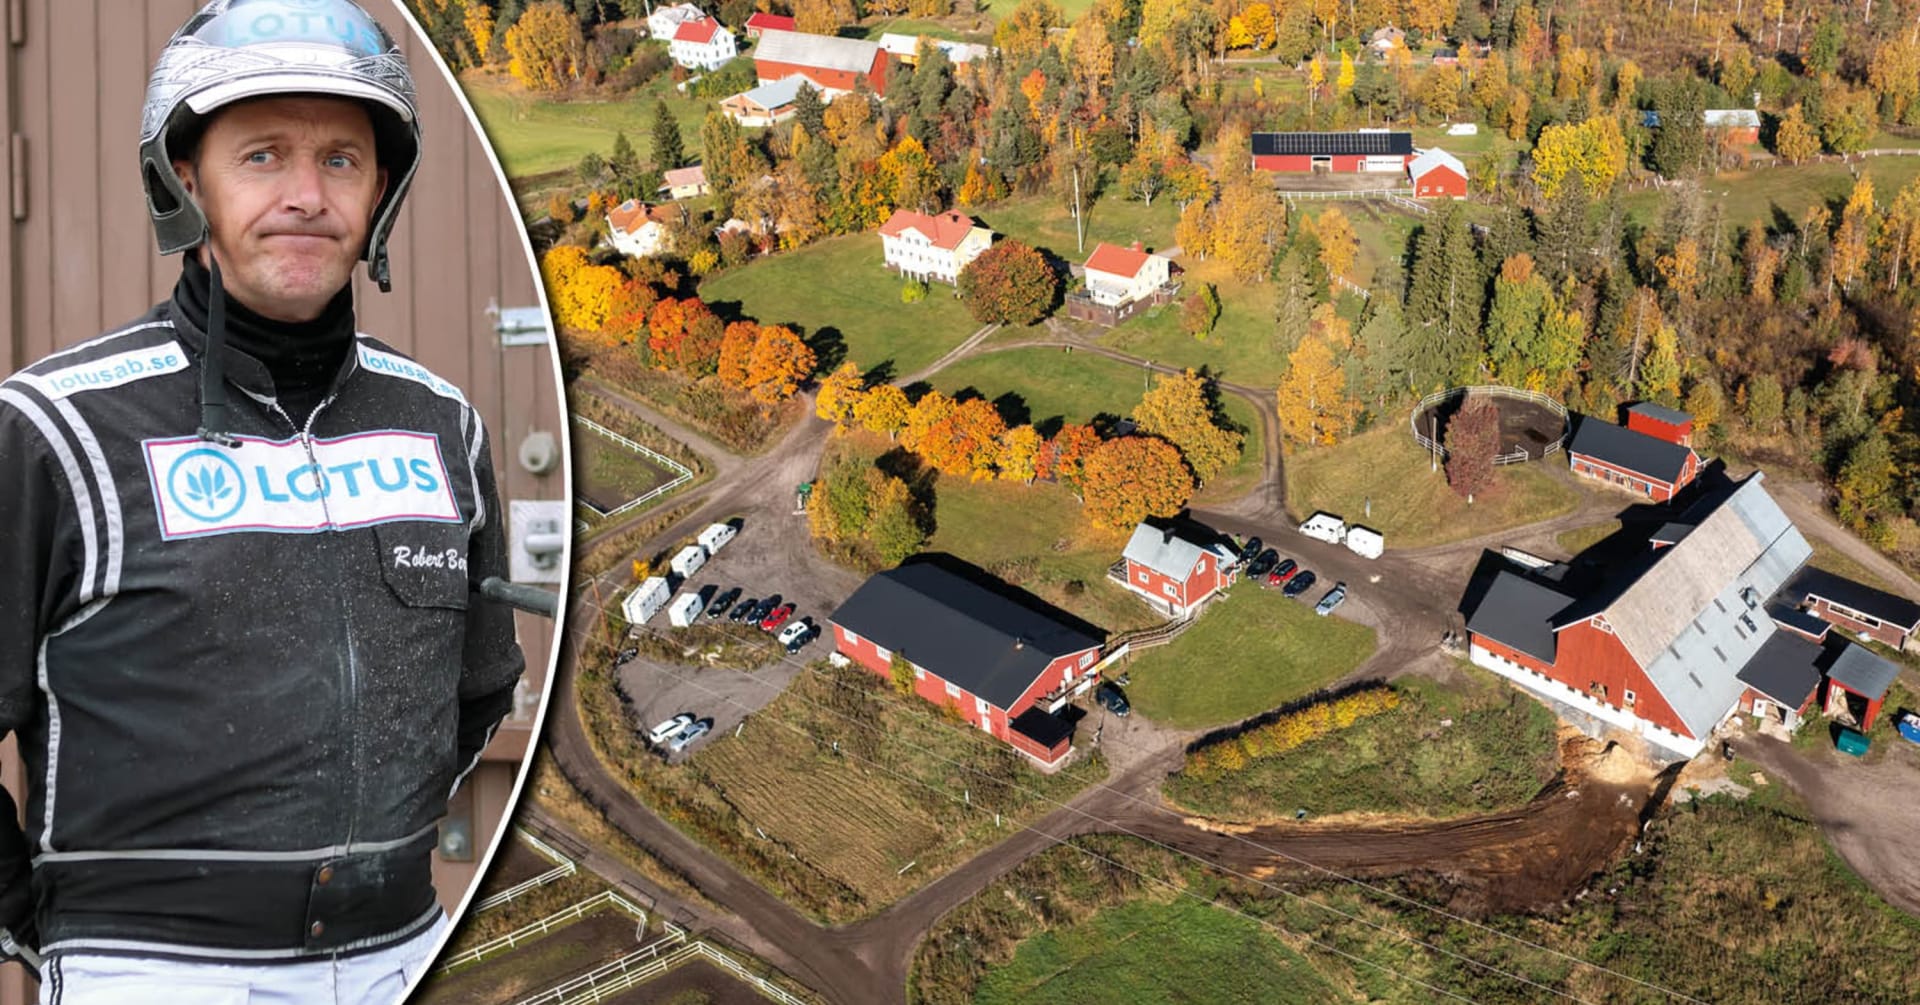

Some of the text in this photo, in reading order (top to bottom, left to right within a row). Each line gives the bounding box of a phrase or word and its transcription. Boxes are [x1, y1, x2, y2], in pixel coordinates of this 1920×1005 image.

[225, 12, 380, 55] LOTUS
[51, 353, 179, 392] lotusab.se
[255, 457, 438, 502] LOTUS
[393, 545, 445, 568] Robert
